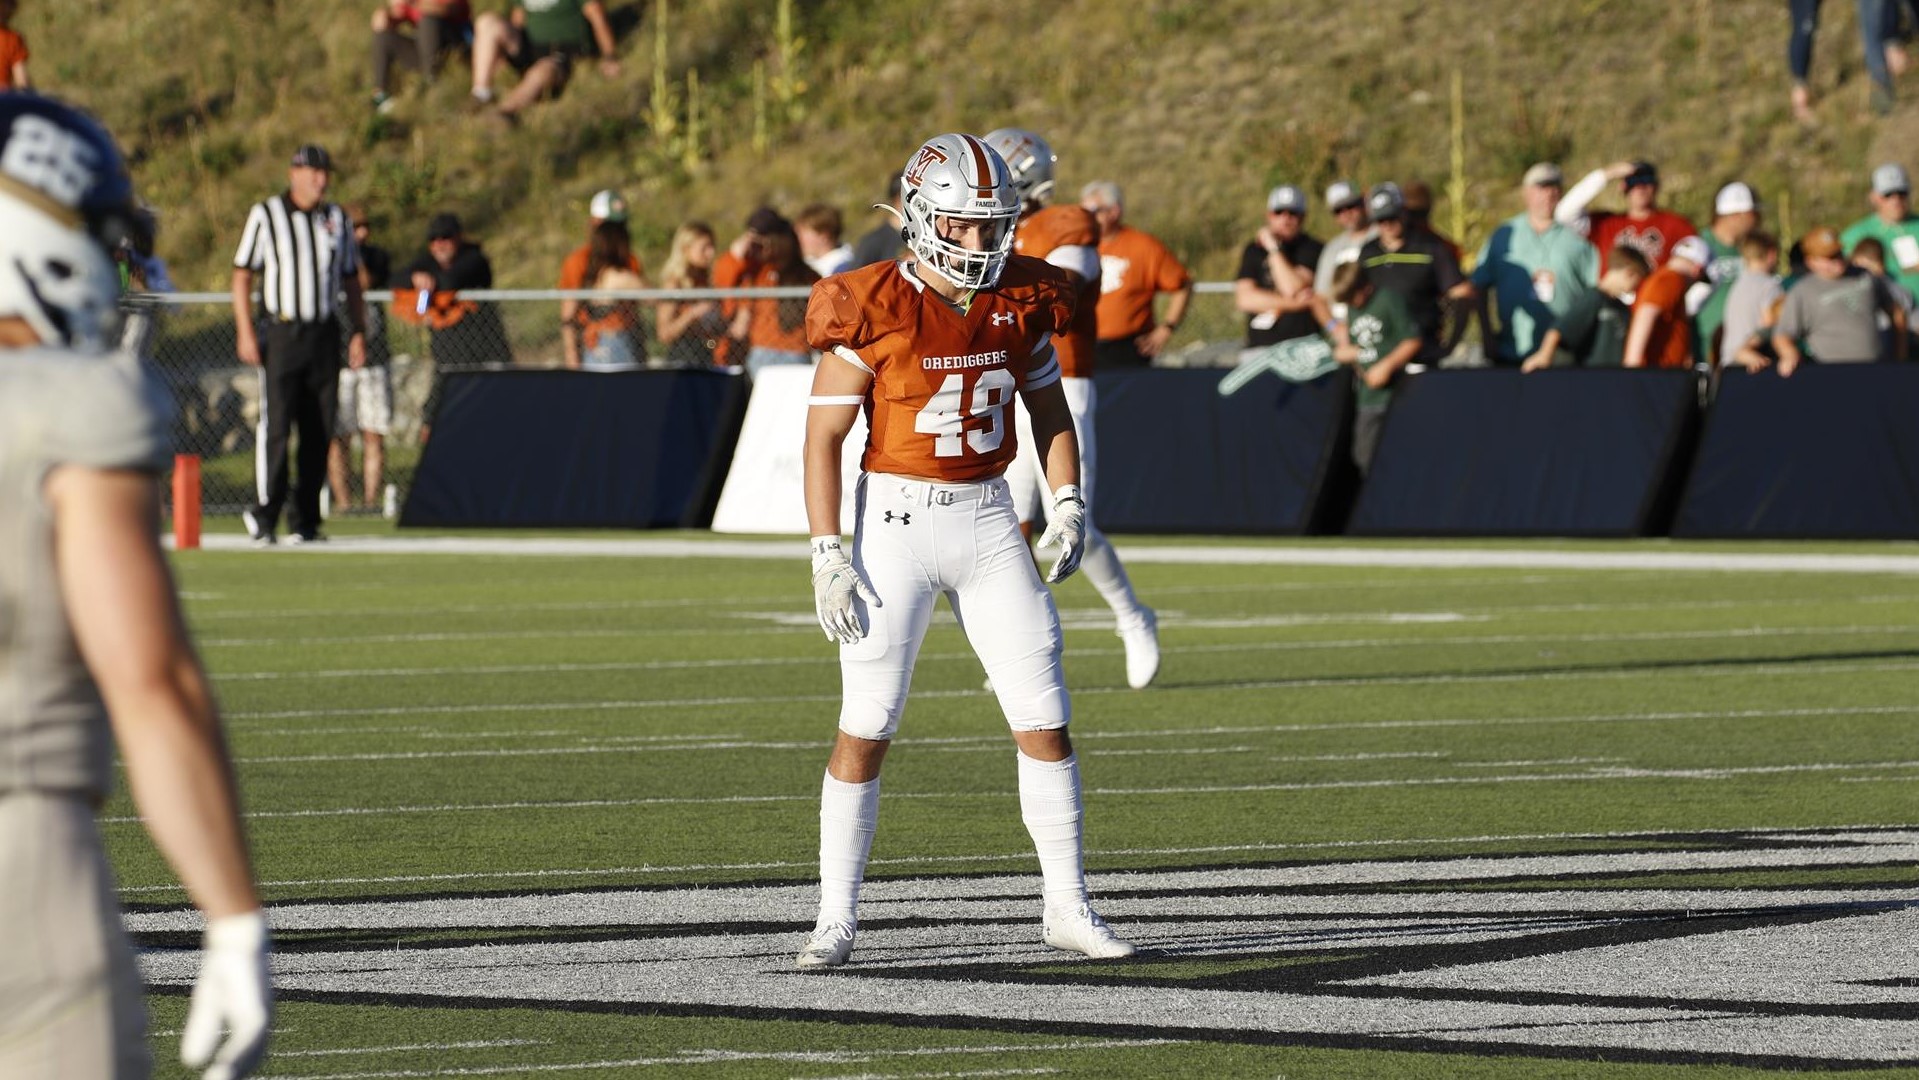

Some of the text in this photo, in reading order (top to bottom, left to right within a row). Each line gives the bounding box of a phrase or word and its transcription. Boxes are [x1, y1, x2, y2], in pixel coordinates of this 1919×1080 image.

[975, 200, 997, 208] FAMILY
[922, 350, 1008, 370] OREDIGGERS
[914, 367, 1016, 457] 49
